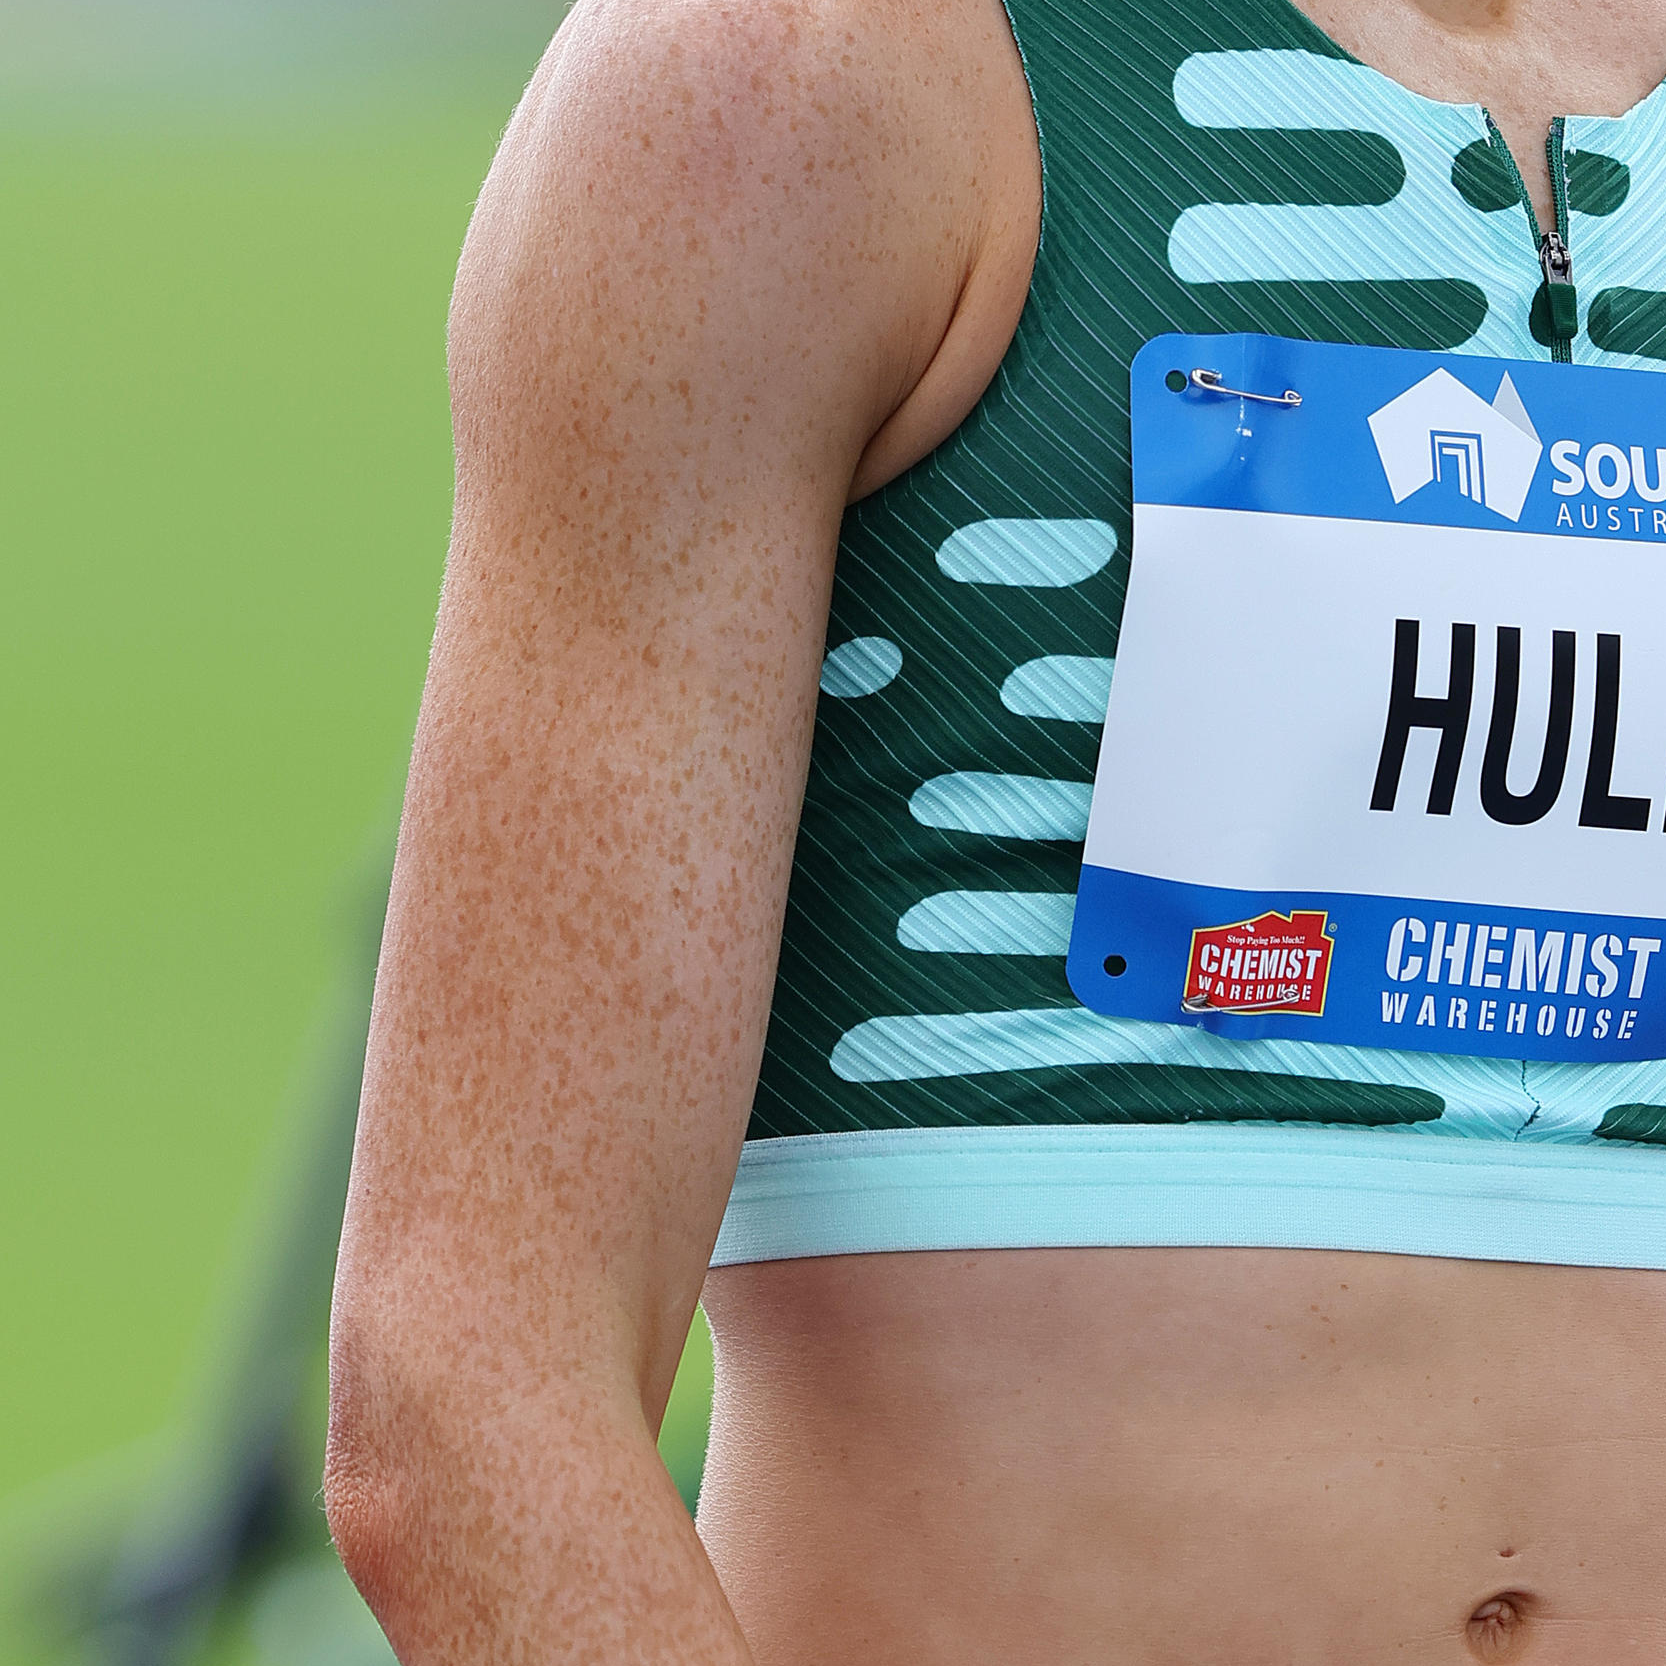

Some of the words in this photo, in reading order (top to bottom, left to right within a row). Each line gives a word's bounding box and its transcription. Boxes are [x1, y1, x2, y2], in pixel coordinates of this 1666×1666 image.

[1227, 934, 1245, 946] Stop
[1386, 917, 1662, 999] CHEMIST
[1200, 944, 1323, 980] CHEMIST
[1381, 991, 1638, 1039] WAREHOUSE
